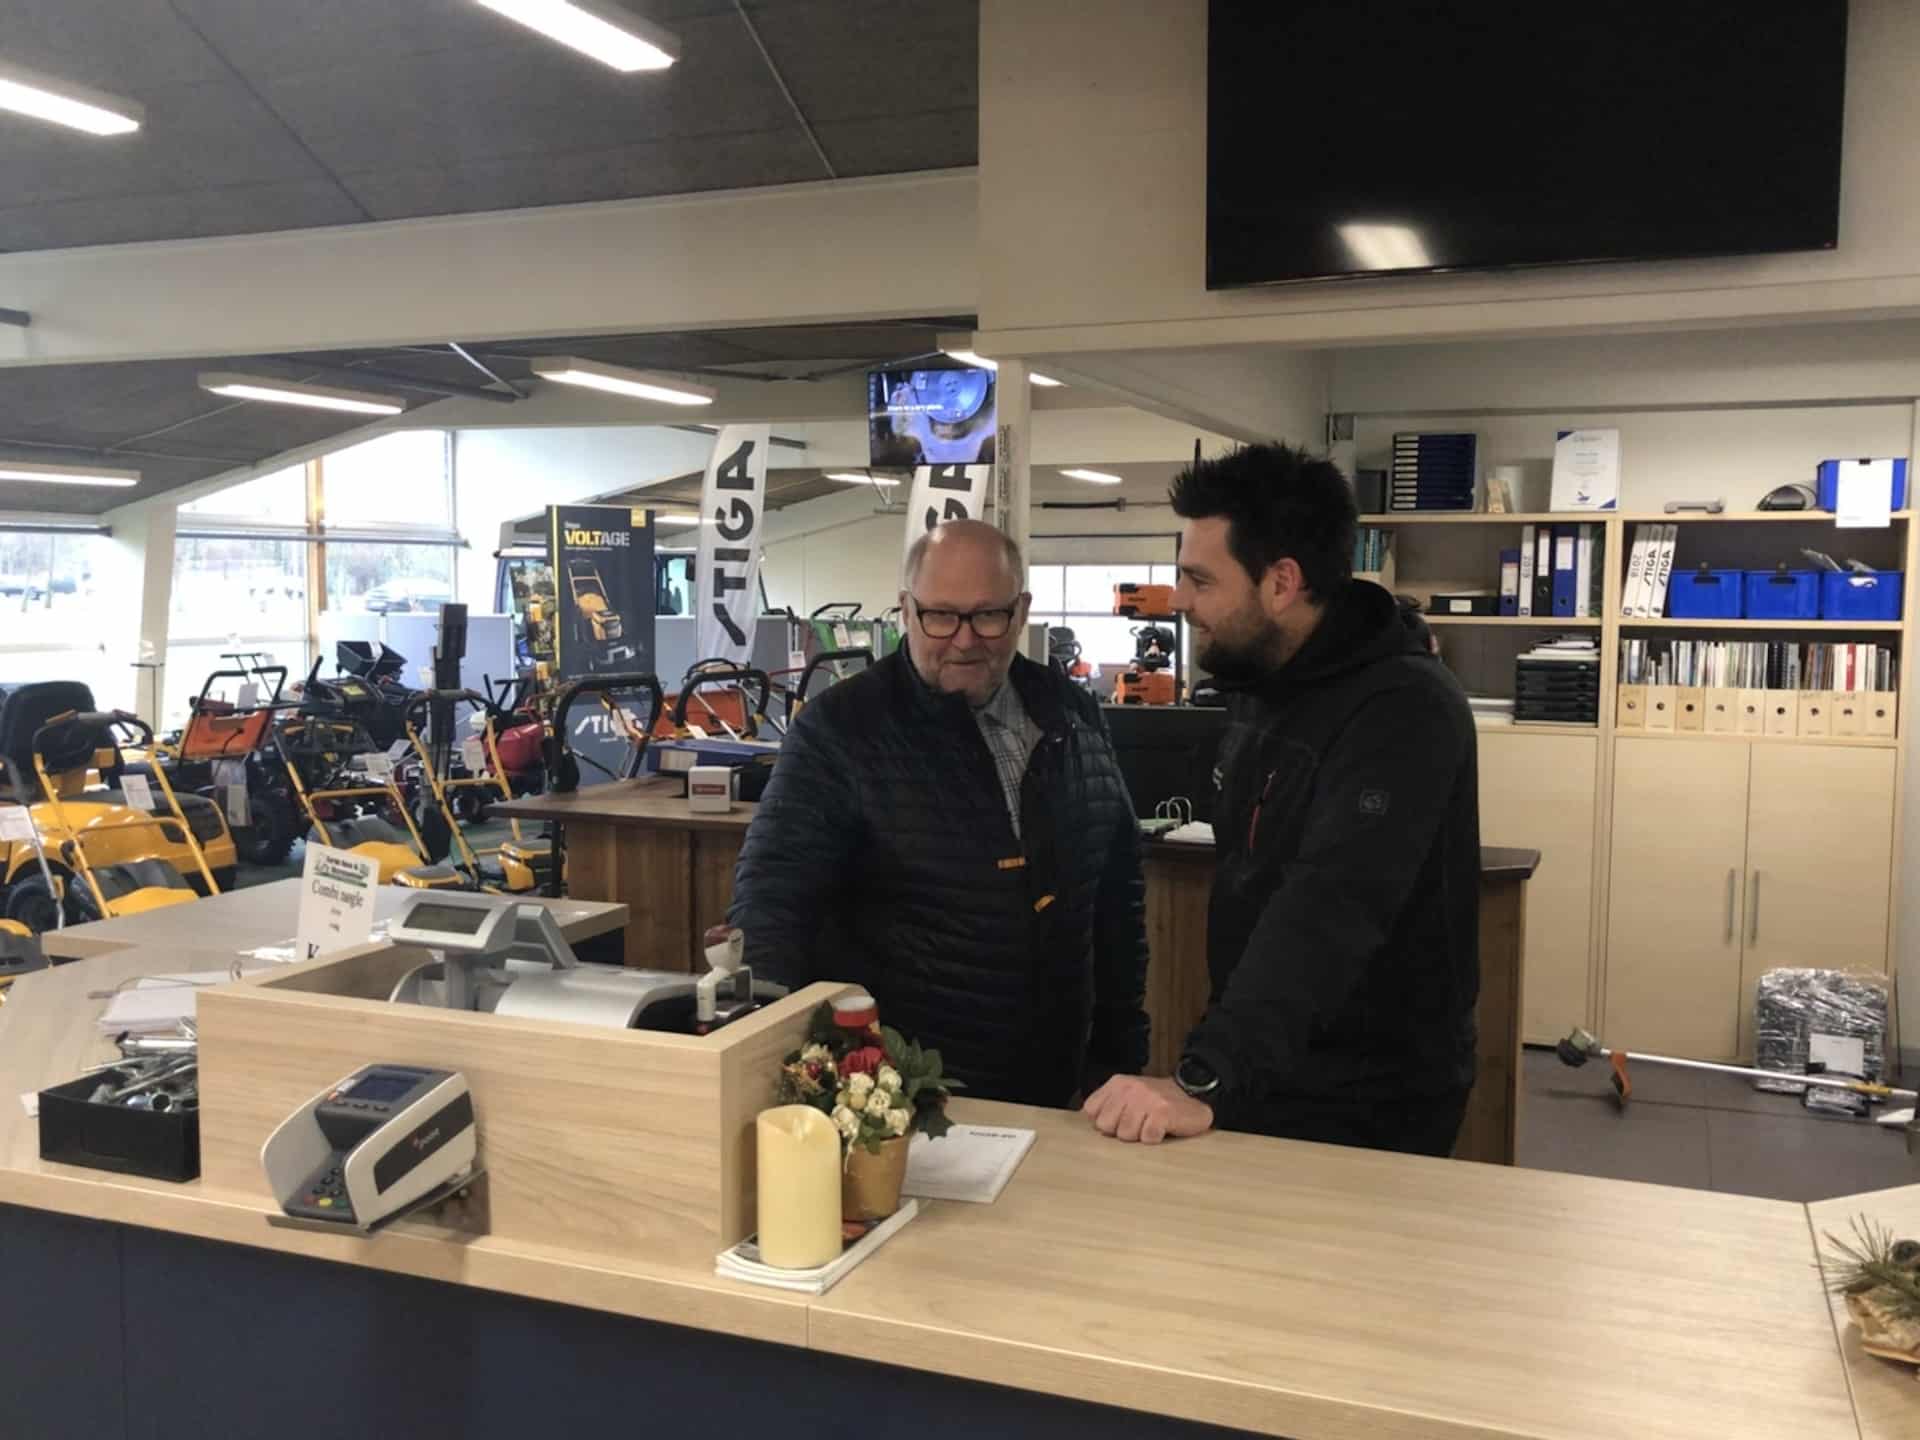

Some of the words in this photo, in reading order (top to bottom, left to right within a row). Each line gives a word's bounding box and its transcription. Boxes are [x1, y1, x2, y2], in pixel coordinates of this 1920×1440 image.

[563, 529, 631, 547] VOLTAGE
[713, 440, 755, 646] STIGA
[1644, 549, 1657, 586] STIGA
[1658, 549, 1672, 587] STIGA
